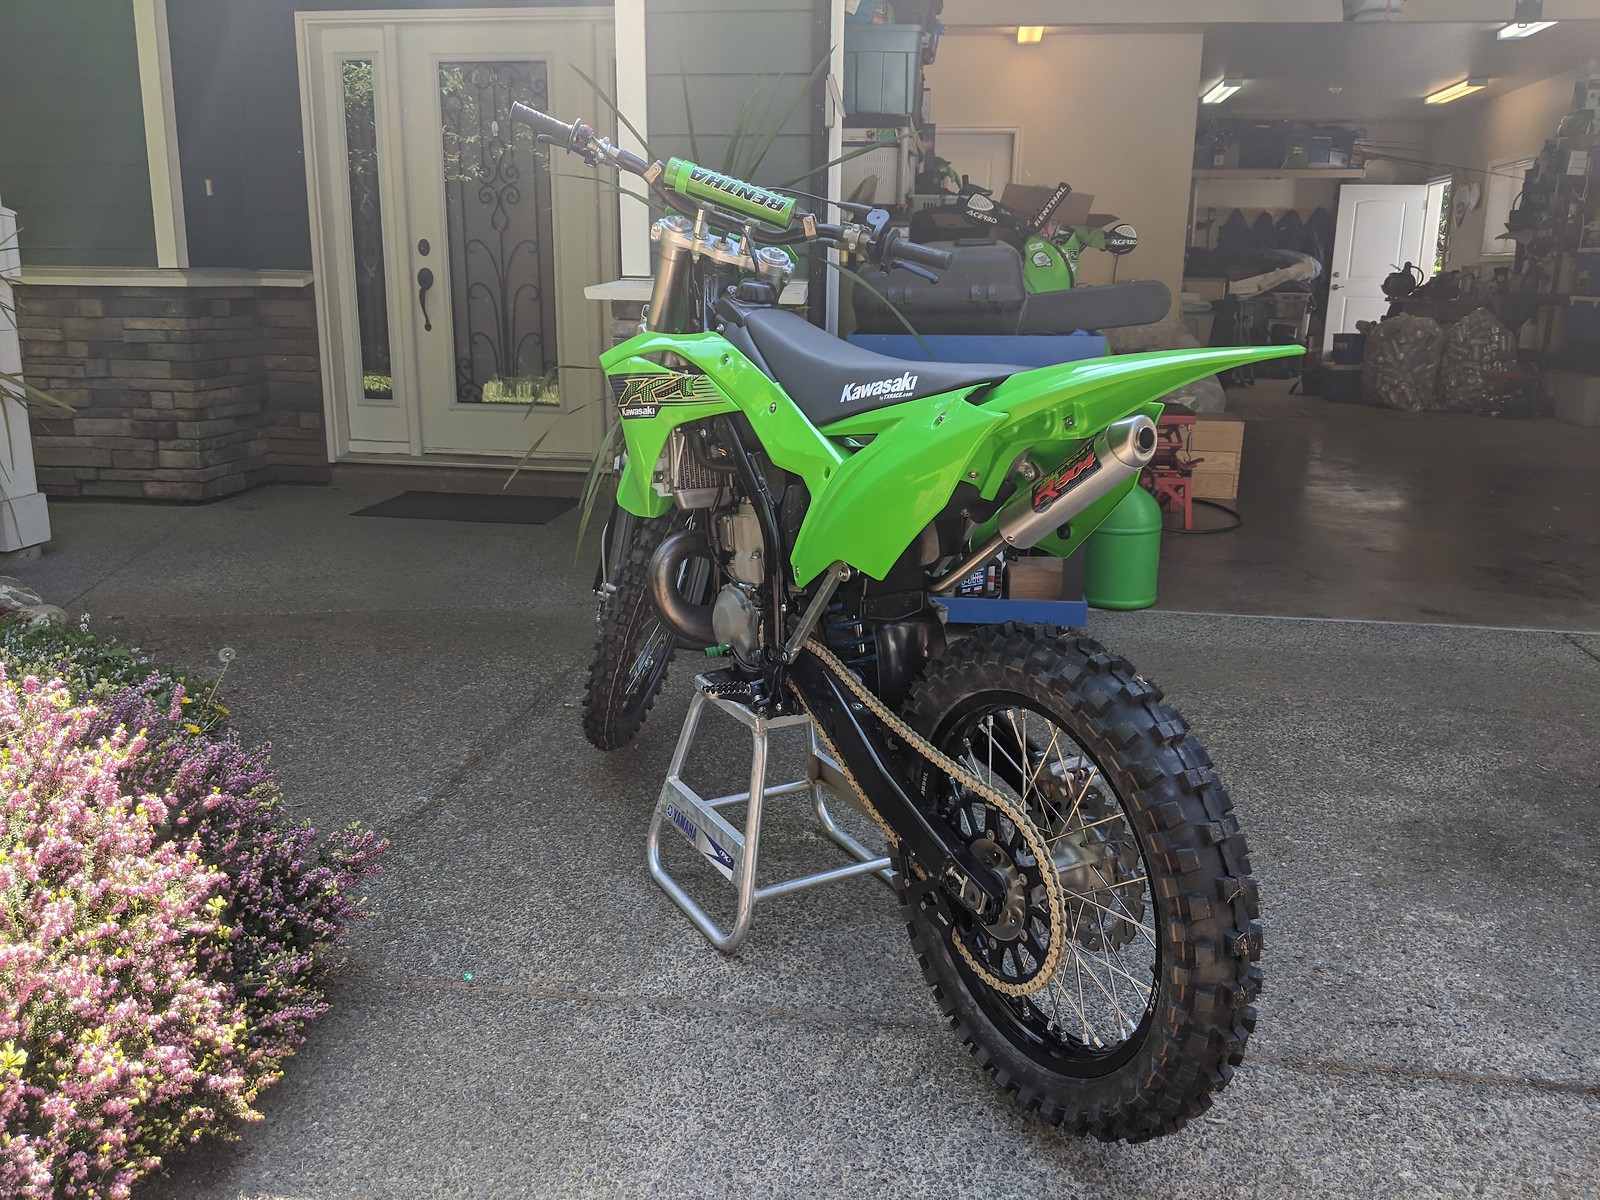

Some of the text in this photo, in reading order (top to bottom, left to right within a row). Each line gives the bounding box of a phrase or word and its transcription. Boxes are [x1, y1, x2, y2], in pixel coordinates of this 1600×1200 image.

[689, 166, 787, 212] RENTHA
[1034, 186, 1067, 227] RENTHAL
[840, 371, 918, 403] Kawasaki
[621, 405, 655, 416] Kawasaki
[674, 807, 697, 842] YAMAHA
